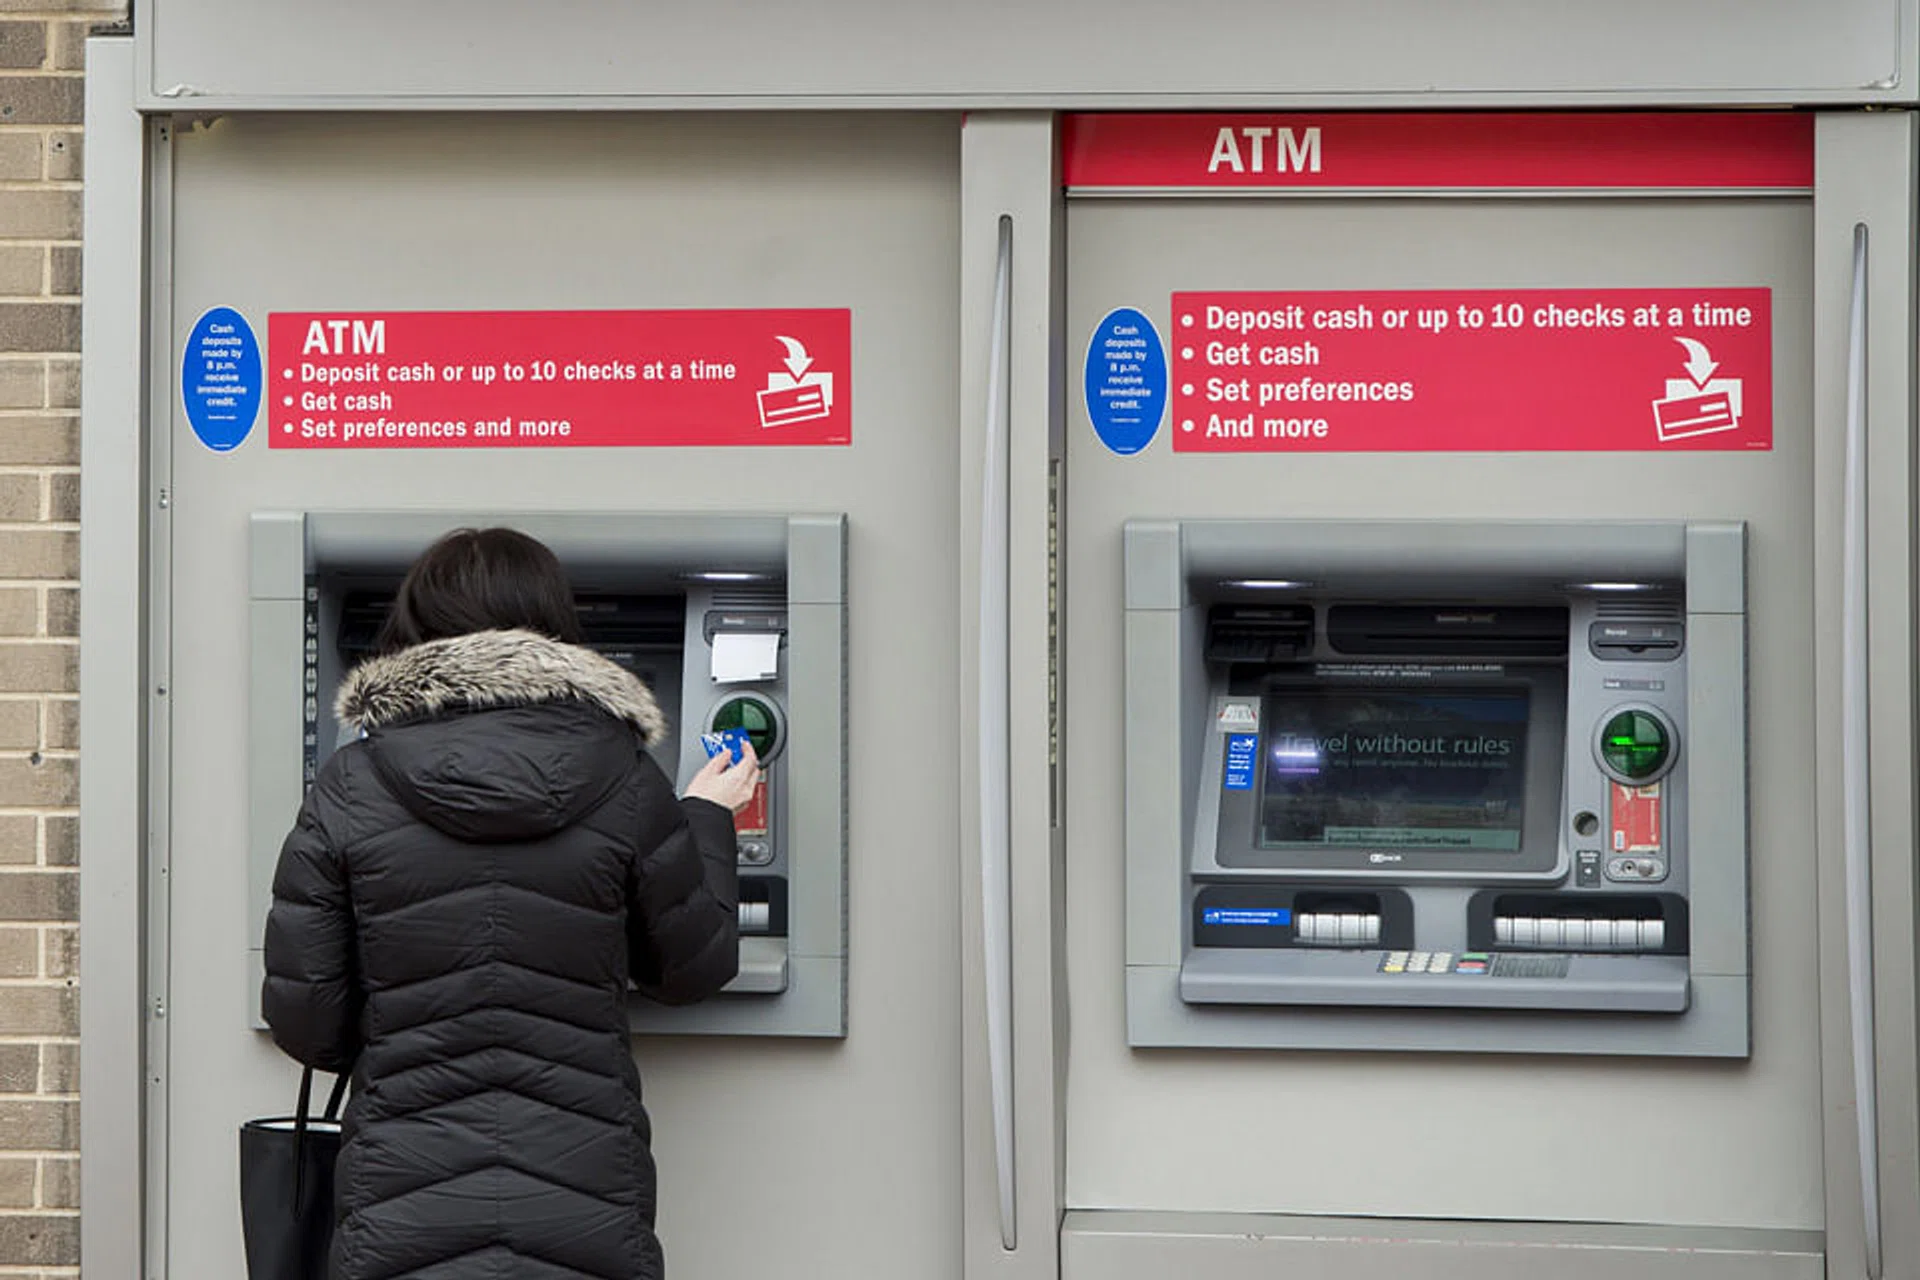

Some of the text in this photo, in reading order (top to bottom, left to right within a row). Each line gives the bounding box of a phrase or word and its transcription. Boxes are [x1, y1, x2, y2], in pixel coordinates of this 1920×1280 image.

[1207, 127, 1321, 173] ATM
[1206, 302, 1752, 335] Deposit cash or up to 10 checks at a time
[302, 319, 385, 355] ATM
[1206, 340, 1320, 366] Get cash
[301, 359, 736, 387] Deposit cash or up to 10 checks at a time
[301, 390, 392, 411] Get cash
[1206, 376, 1414, 407] Set preferences
[301, 416, 571, 442] Set preferences and more
[1205, 413, 1329, 438] And more
[1356, 733, 1446, 754] without
[1454, 735, 1511, 755] rules
